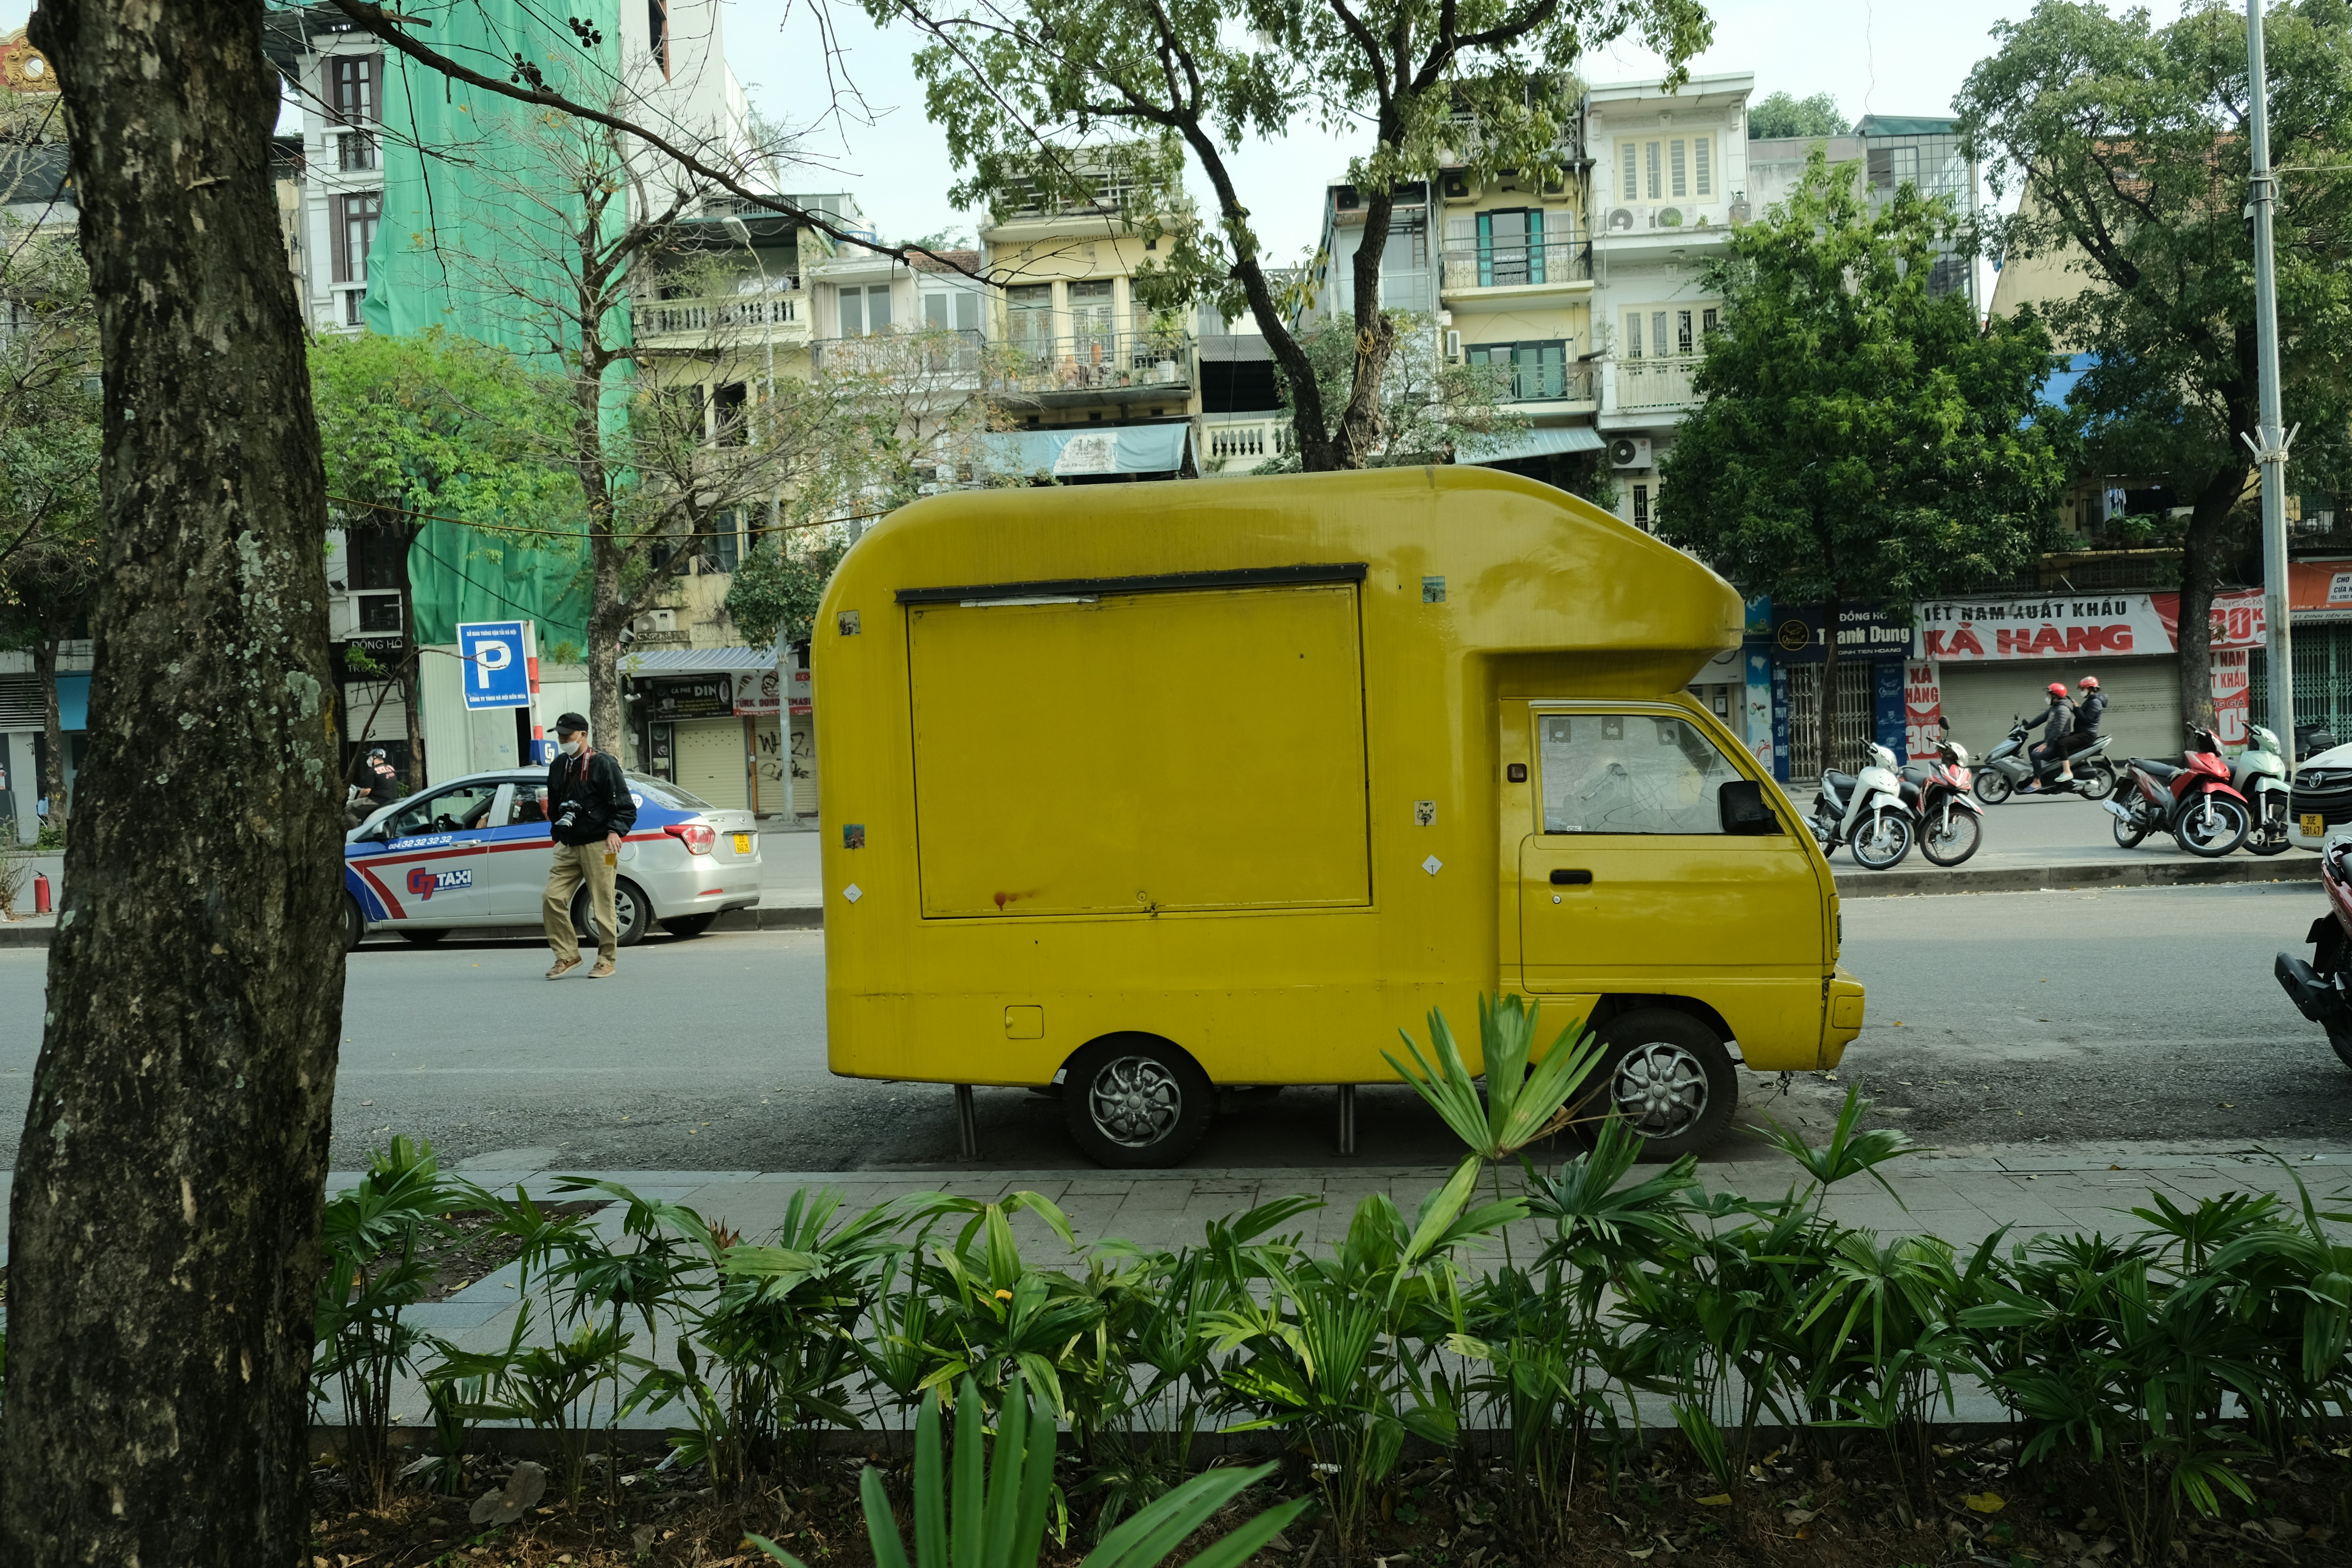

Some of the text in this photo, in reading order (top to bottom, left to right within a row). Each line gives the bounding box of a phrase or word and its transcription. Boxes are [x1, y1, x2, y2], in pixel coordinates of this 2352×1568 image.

[1924, 604, 1951, 623] IỆT
[1962, 607, 2005, 620] NAM
[2073, 597, 2126, 617] KHẨU
[1816, 626, 1909, 645] Tanh Dung
[1997, 623, 2133, 654] HÀNG
[475, 641, 511, 689] P
[2220, 651, 2246, 667] NAM
[1910, 664, 1932, 684] XẢ
[2221, 668, 2246, 688] KHẨU
[694, 685, 717, 696] DIN
[1905, 685, 1939, 704] HÀNG
[735, 698, 755, 707] TÜRK
[2228, 697, 2245, 707] GIÁ
[2219, 707, 2248, 741] 0K
[1775, 743, 1788, 758] NHẬT
[2306, 816, 2316, 825] 30E
[2303, 826, 2320, 835] 691.47
[407, 867, 471, 901] G7 TAXI
